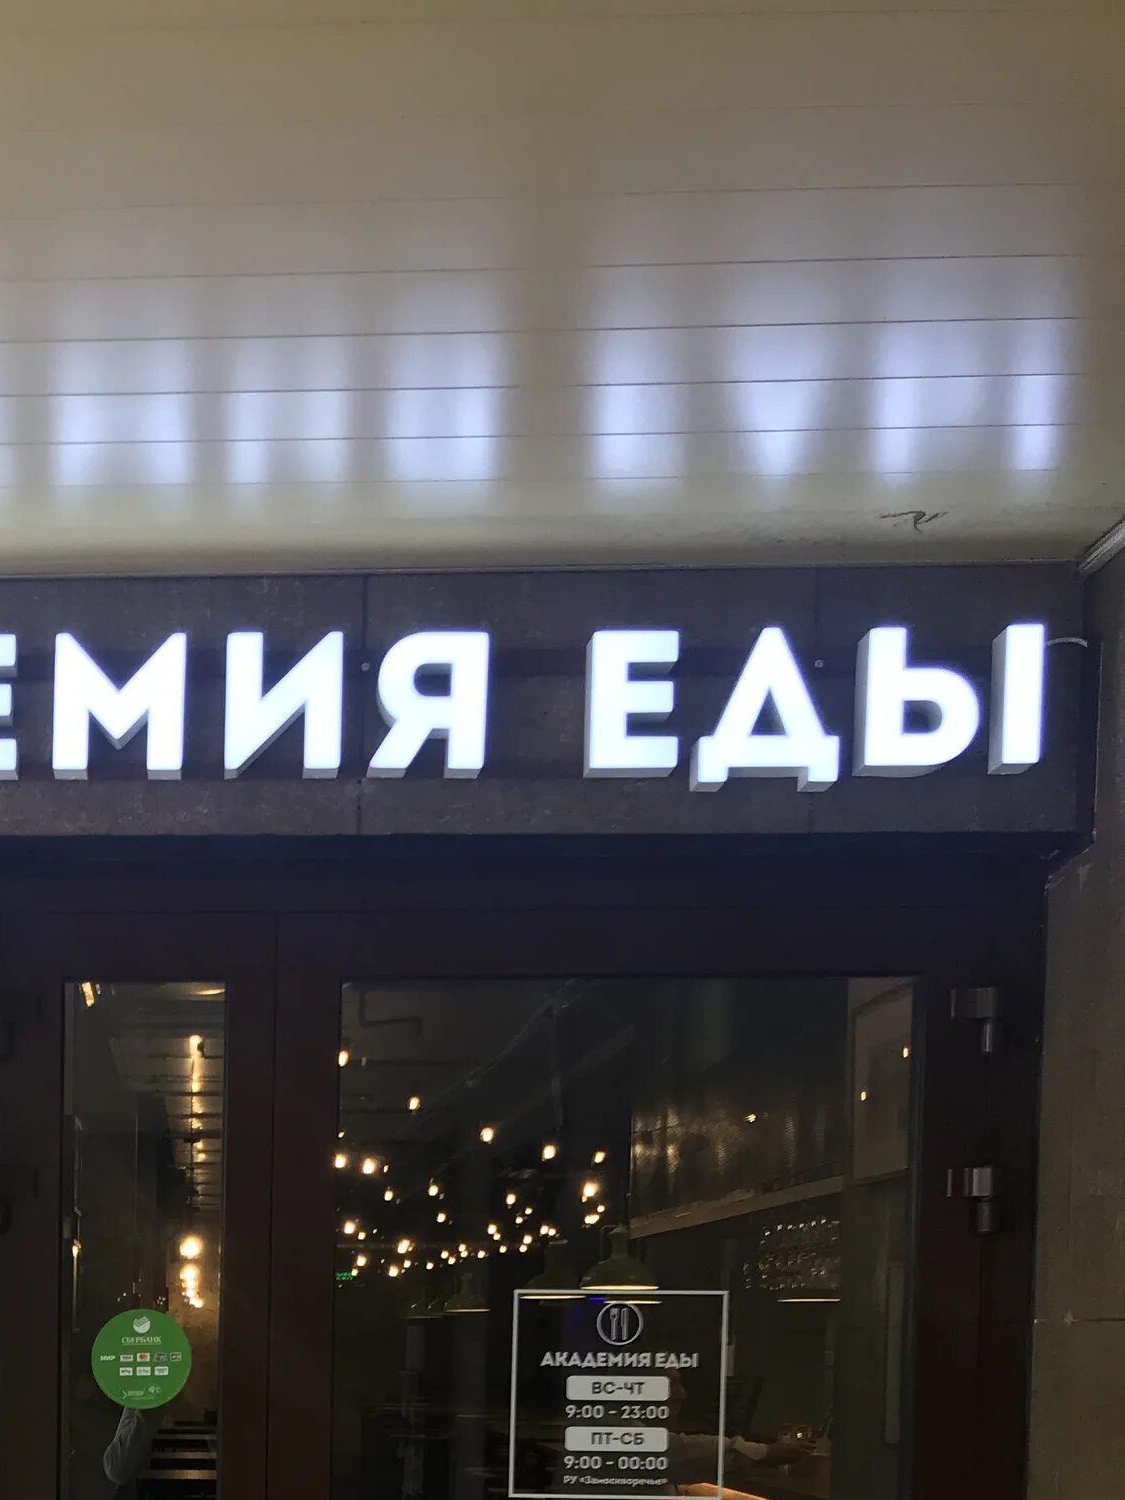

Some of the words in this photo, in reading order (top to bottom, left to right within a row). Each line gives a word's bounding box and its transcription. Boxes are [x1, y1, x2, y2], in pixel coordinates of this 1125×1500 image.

[583, 623, 1046, 793] ЕДЫ
[540, 1351, 652, 1367] АКАДЕМИЯ
[655, 1353, 699, 1368] ЕДЫ
[591, 1382, 645, 1395] ВС-ЧТ
[565, 1405, 604, 1419] 9:00
[620, 1405, 669, 1419] 23:00
[590, 1432, 644, 1445] ПТ-СБ
[563, 1456, 602, 1470] 9:00
[617, 1457, 668, 1470] 00:00
